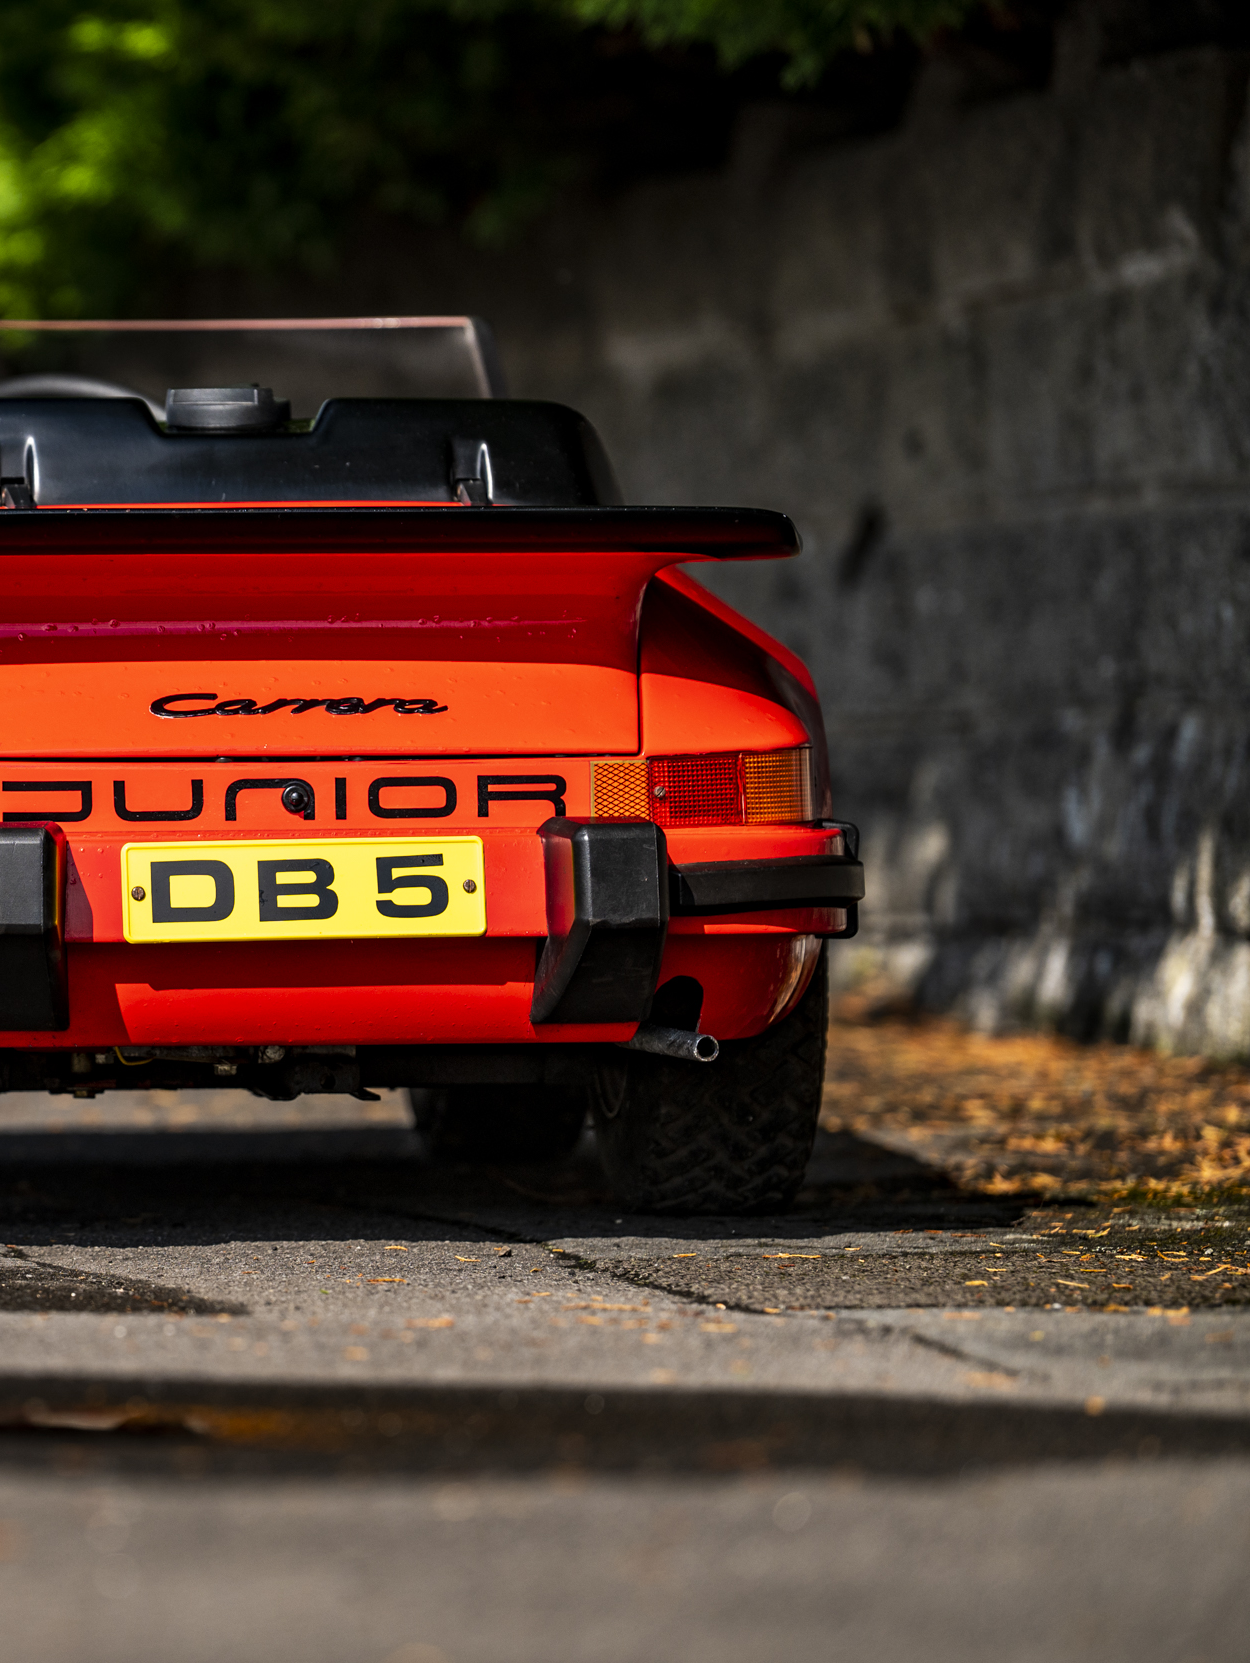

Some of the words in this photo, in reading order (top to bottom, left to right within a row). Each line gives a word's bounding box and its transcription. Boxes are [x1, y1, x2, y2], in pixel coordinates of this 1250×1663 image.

[149, 692, 450, 719] Carrera
[2, 774, 567, 822] JUNIOR
[150, 857, 339, 923] DB
[375, 853, 449, 918] 5
